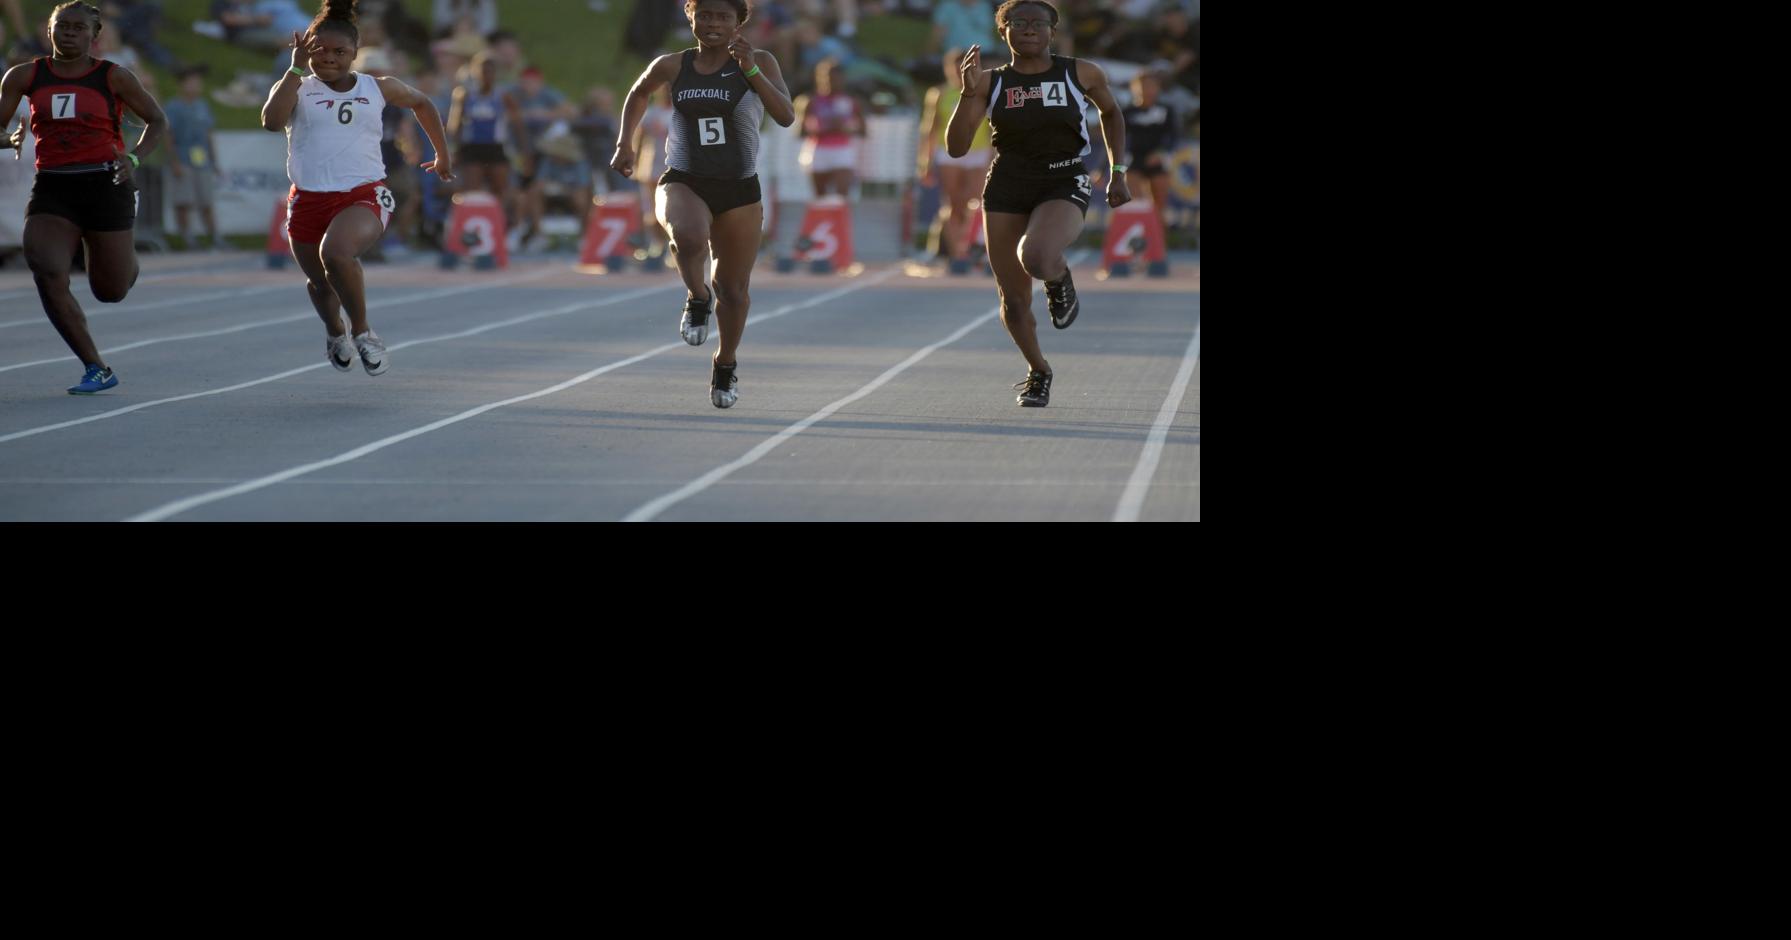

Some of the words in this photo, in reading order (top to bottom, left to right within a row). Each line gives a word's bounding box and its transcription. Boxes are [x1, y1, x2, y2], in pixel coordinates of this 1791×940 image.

[677, 88, 731, 102] STOCKDALE
[1047, 84, 1063, 104] 4
[57, 96, 70, 117] 7
[338, 101, 352, 124] 6
[705, 120, 720, 143] 5
[1049, 160, 1071, 169] NIKE
[380, 189, 391, 208] 6
[596, 217, 628, 257] 7
